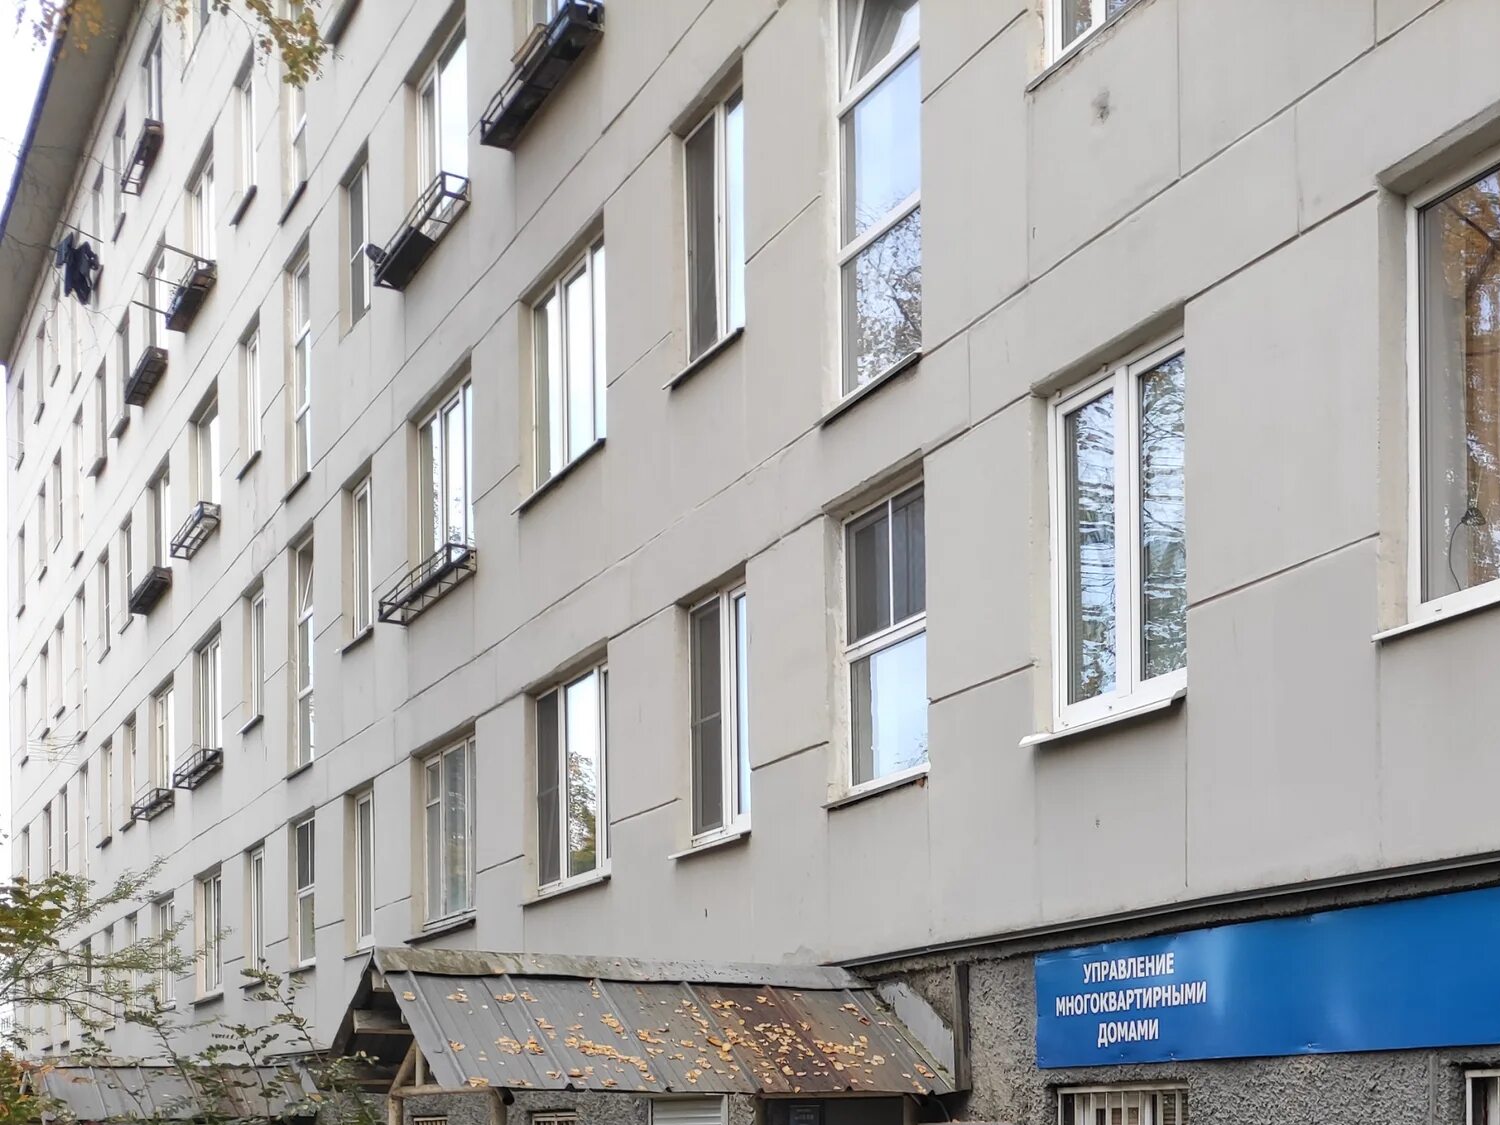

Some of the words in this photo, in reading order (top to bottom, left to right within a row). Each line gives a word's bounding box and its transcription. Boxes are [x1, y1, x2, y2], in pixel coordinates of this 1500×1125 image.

[1083, 952, 1175, 983] УПРАВЛЕНИЕ
[1055, 981, 1207, 1017] МНОГОКВАРТИРНЫМИ
[1097, 1018, 1159, 1048] ДОМАМИ
